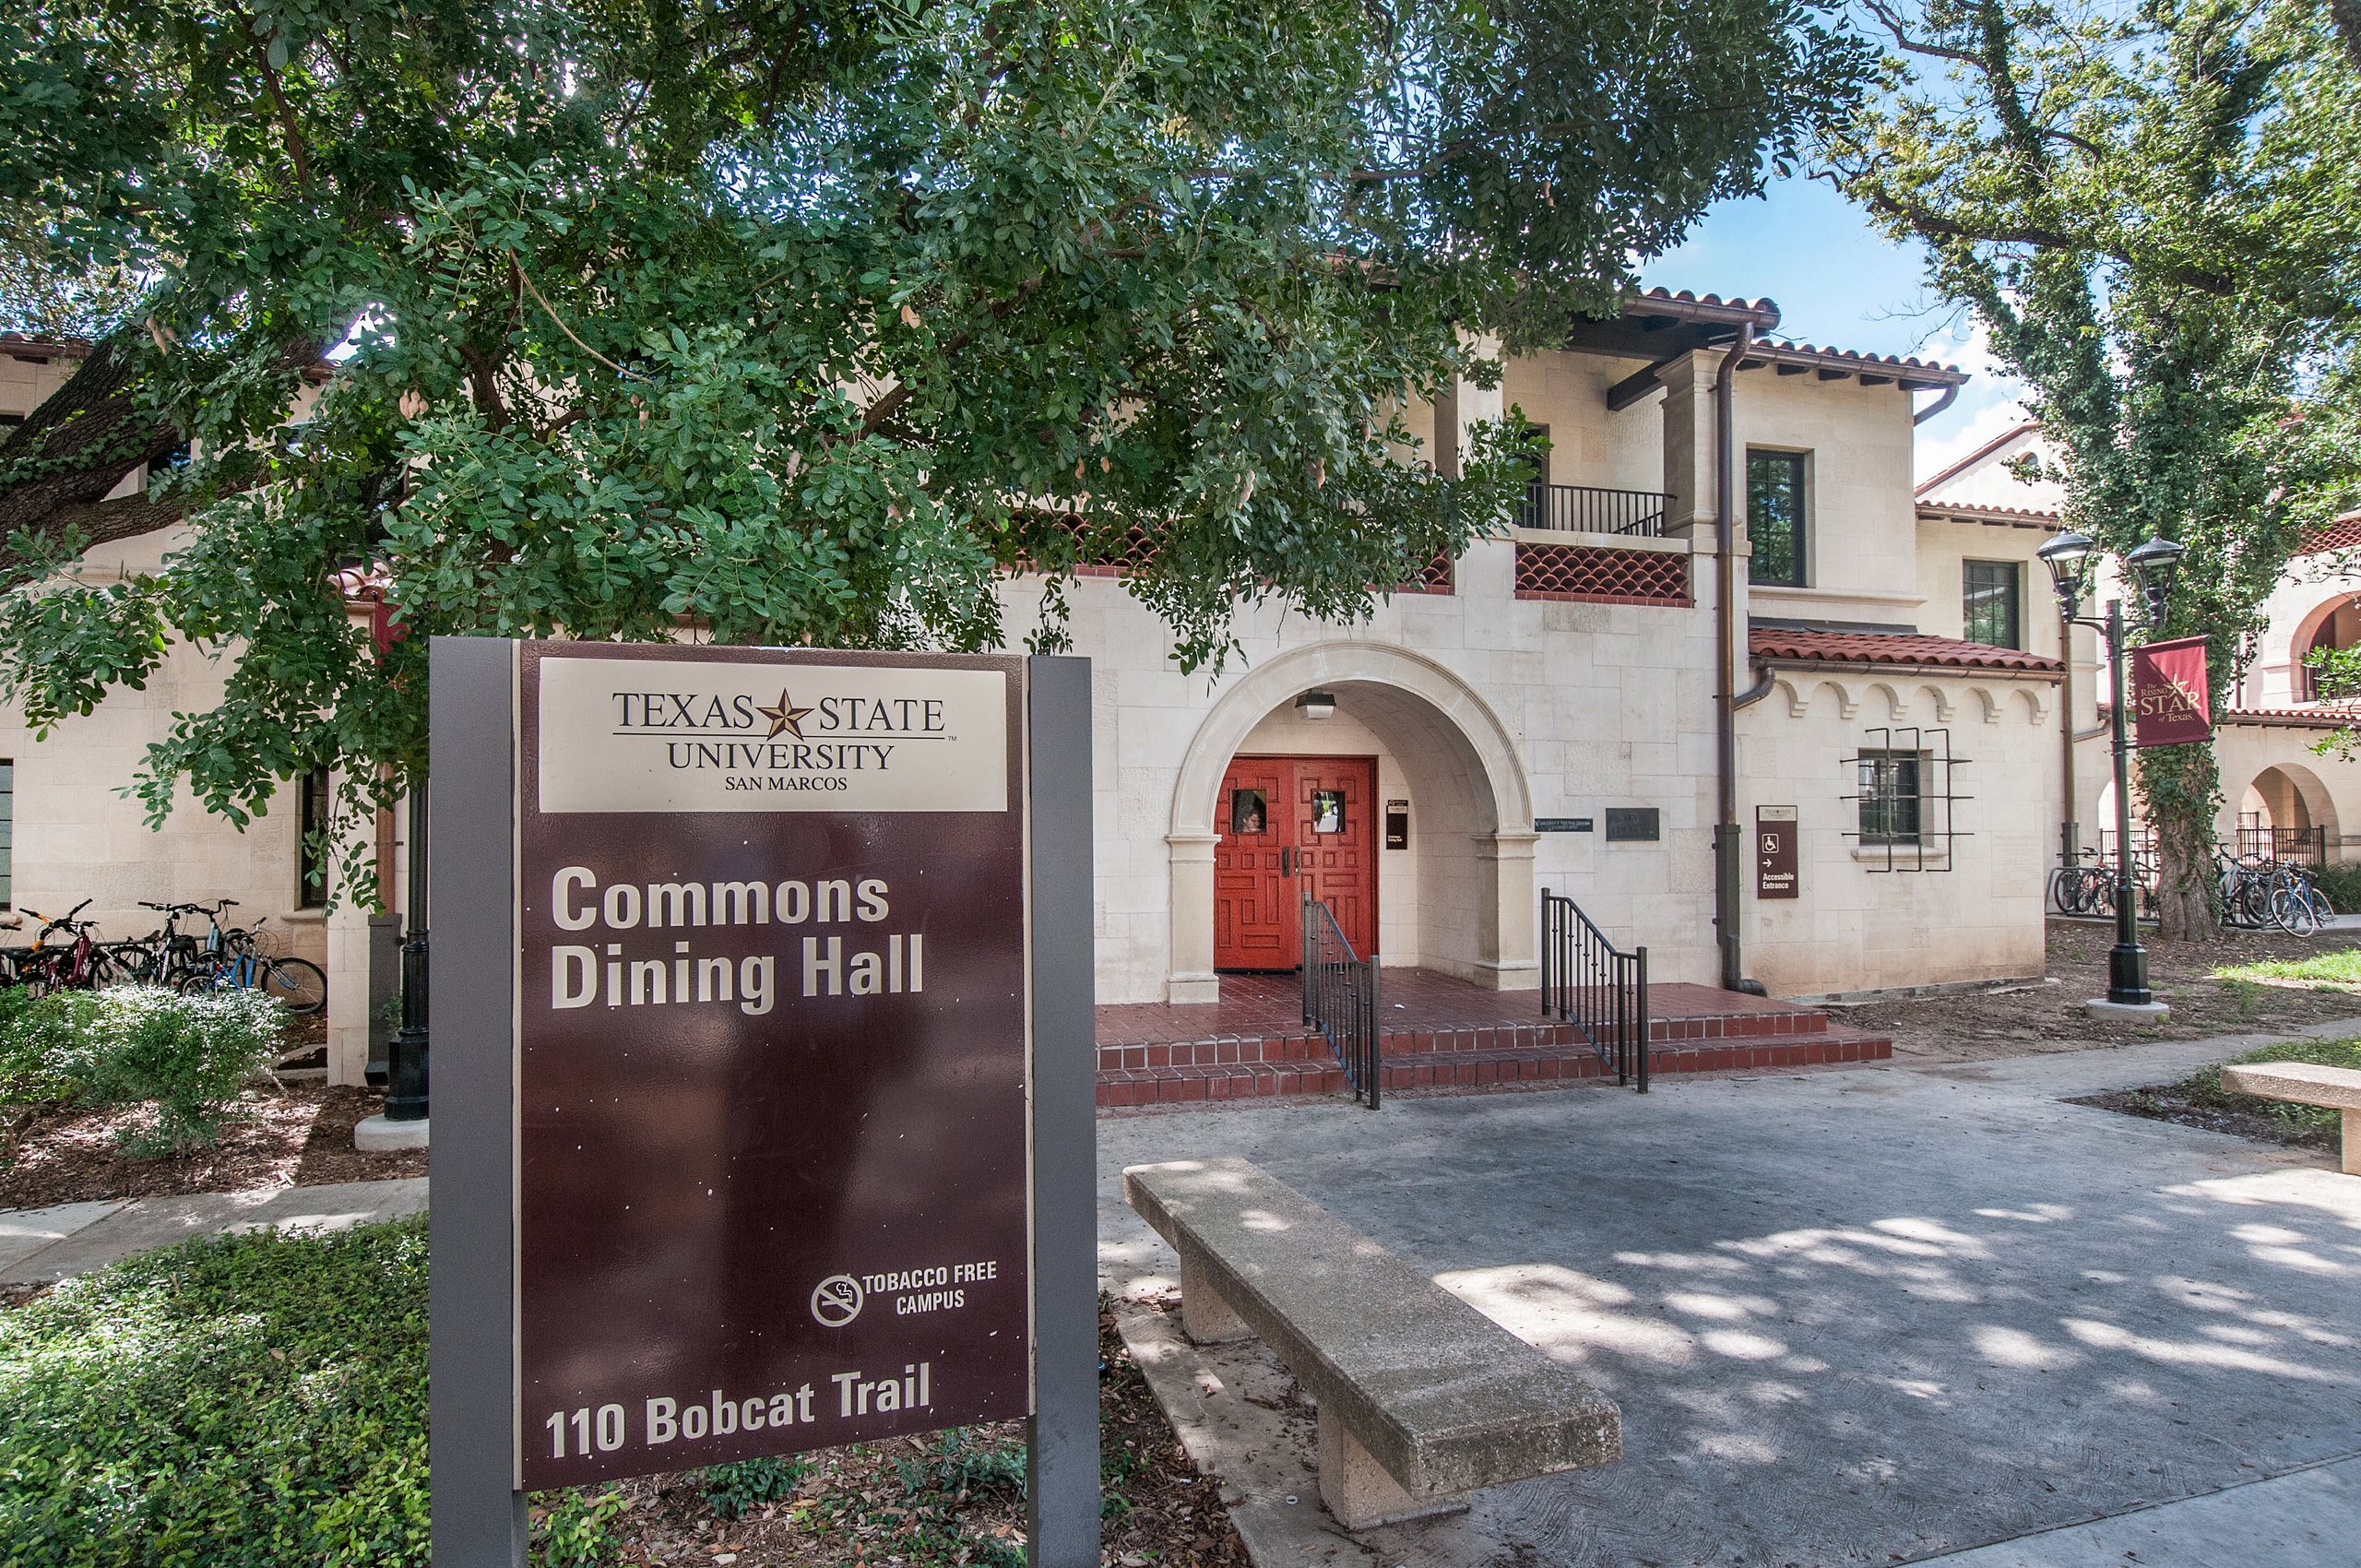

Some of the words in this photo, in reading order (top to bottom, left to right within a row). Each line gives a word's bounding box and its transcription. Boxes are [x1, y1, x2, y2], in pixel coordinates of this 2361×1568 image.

[2140, 691, 2202, 716] STAR
[2141, 688, 2167, 697] RISING
[611, 692, 754, 730] TEXAS
[819, 696, 945, 731] STATE
[666, 742, 896, 770] UNIVERSITY
[725, 776, 764, 791] SAN
[767, 776, 848, 791] MARCOS
[552, 866, 889, 931] Commons
[1762, 881, 1789, 889] Entrance
[552, 941, 775, 1016] Dining
[802, 933, 923, 997] Hall
[862, 1267, 948, 1294] TOBACCO
[954, 1260, 997, 1284] FREE
[896, 1289, 965, 1315] CAMPUS
[546, 1403, 625, 1458] 110
[646, 1383, 815, 1445] Bobcat
[831, 1361, 930, 1418] Trail
